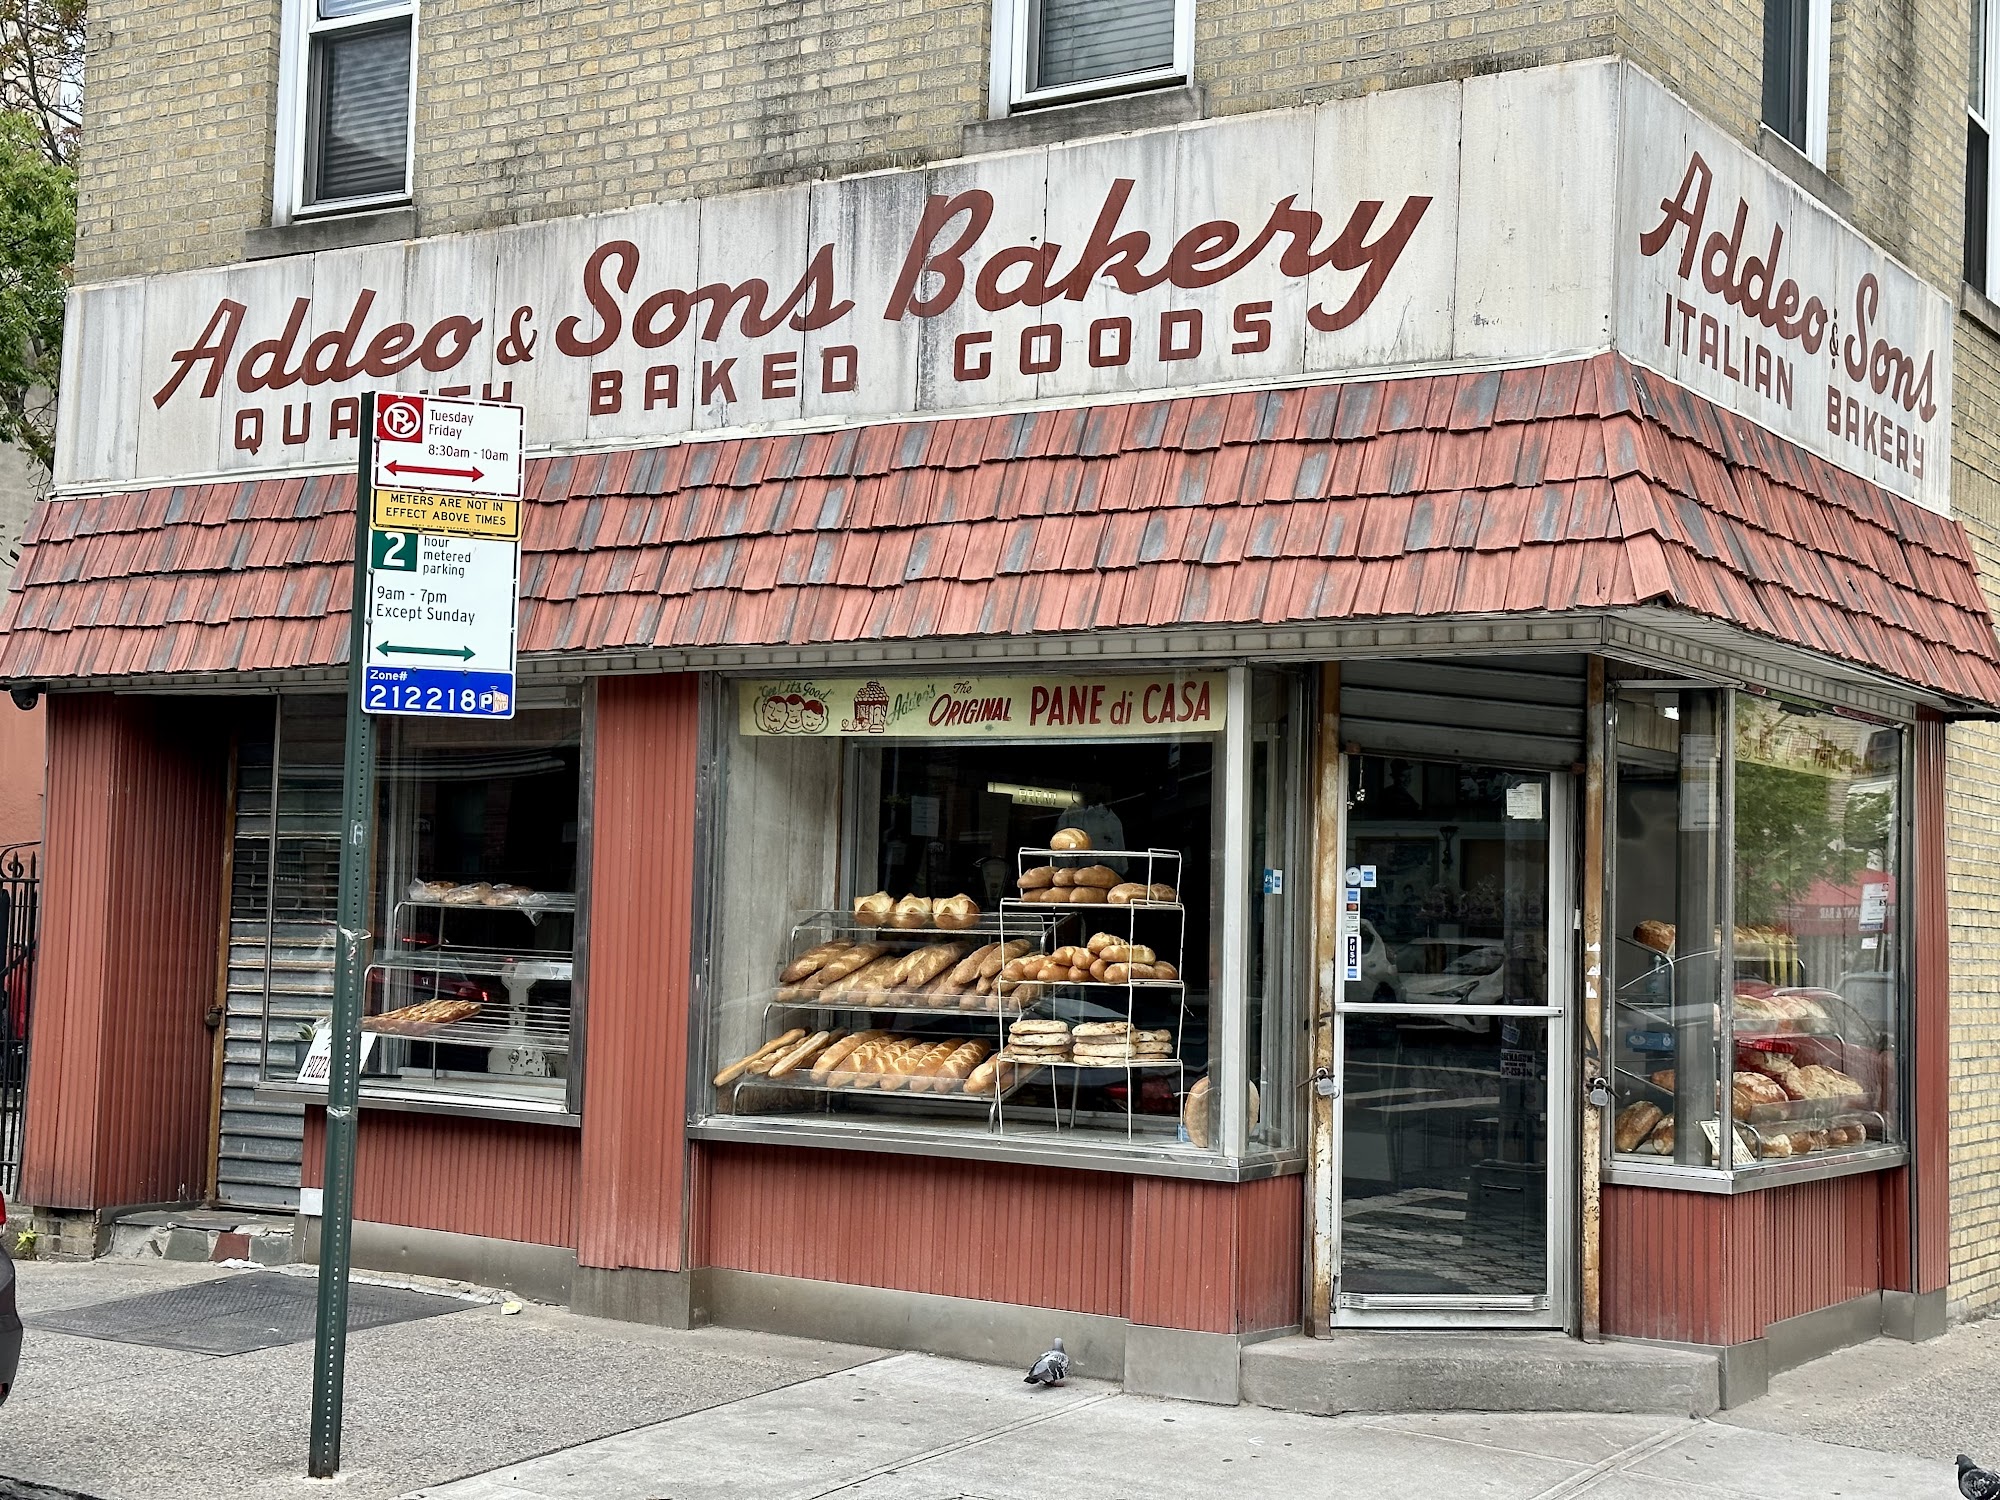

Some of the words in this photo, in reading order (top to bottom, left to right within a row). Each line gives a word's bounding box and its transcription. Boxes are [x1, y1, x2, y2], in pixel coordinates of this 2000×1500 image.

[154, 288, 482, 409] Addeo
[496, 305, 537, 365] &
[555, 240, 854, 356] Sons
[884, 178, 1433, 332] Bakery
[1640, 151, 1828, 354] Addeo
[1844, 273, 1937, 423] Sons
[590, 345, 858, 415] BAKED
[953, 301, 1273, 381] GOODS
[1664, 293, 1793, 411] ITALIAN
[1827, 385, 1925, 480] BAKERY
[430, 409, 474, 426] Tuesday
[428, 424, 462, 439] Friday
[428, 444, 470, 458] 8:30am
[481, 448, 509, 461] 10am
[390, 493, 434, 505] METERS
[439, 497, 462, 508] ARE
[466, 499, 488, 510] NOT
[492, 501, 504, 512] IN
[386, 507, 427, 519] EFFECT
[432, 511, 470, 522] ABOVE
[475, 514, 507, 526] TIMES
[382, 532, 406, 567] 2
[424, 536, 450, 548] hour
[423, 550, 471, 563] metered
[423, 563, 465, 578] parking
[376, 585, 405, 601] 9am
[420, 588, 447, 605] 7pm
[376, 603, 422, 621] Except
[427, 607, 475, 625] Sunday
[370, 669, 408, 681] Zone#
[953, 680, 972, 694] The
[370, 684, 476, 712] 212218
[1030, 685, 1106, 726] PANE
[1110, 690, 1134, 725] di
[1142, 681, 1211, 724] CASA
[928, 693, 1012, 727] ORIGINAL
[1348, 938, 1356, 965] PUSH
